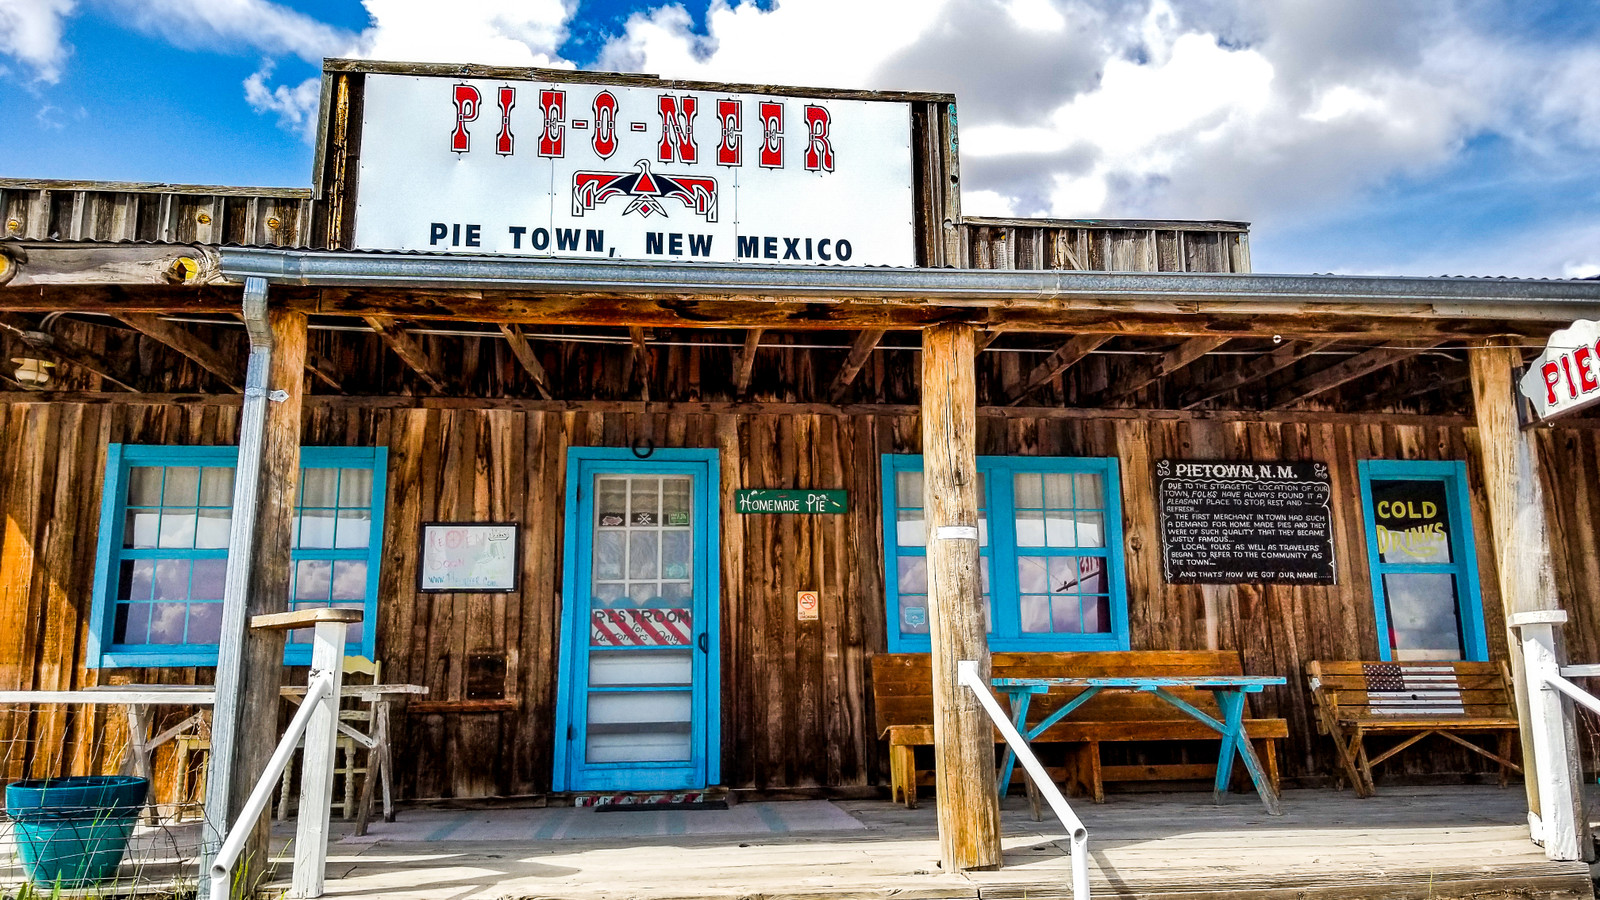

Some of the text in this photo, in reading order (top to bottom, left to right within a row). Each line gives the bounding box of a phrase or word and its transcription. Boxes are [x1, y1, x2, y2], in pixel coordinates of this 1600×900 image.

[450, 82, 835, 174] PIE-O-NEER
[429, 222, 853, 262] PIE TOWN, NEW MEXICO
[1541, 336, 1600, 407] PIE
[1163, 490, 1190, 499] TOWN,
[1191, 490, 1218, 498] FOLKS
[1243, 491, 1276, 499] ALWAYS
[740, 493, 800, 512] HOMEMADE
[1243, 499, 1266, 507] STOP,
[1267, 499, 1284, 507] REST,
[1377, 500, 1438, 518] COLD
[1376, 522, 1446, 557] DRINKS
[1181, 543, 1207, 551] LOCAL
[1210, 543, 1231, 551] FOLKS
[1247, 543, 1266, 551] WELL
[1278, 544, 1320, 552] TRAVELERS
[1209, 551, 1231, 559] REFER
[1278, 571, 1296, 579] OUR
[594, 610, 690, 624] RESTROOM
[631, 622, 643, 633] for
[654, 630, 680, 646] Only
